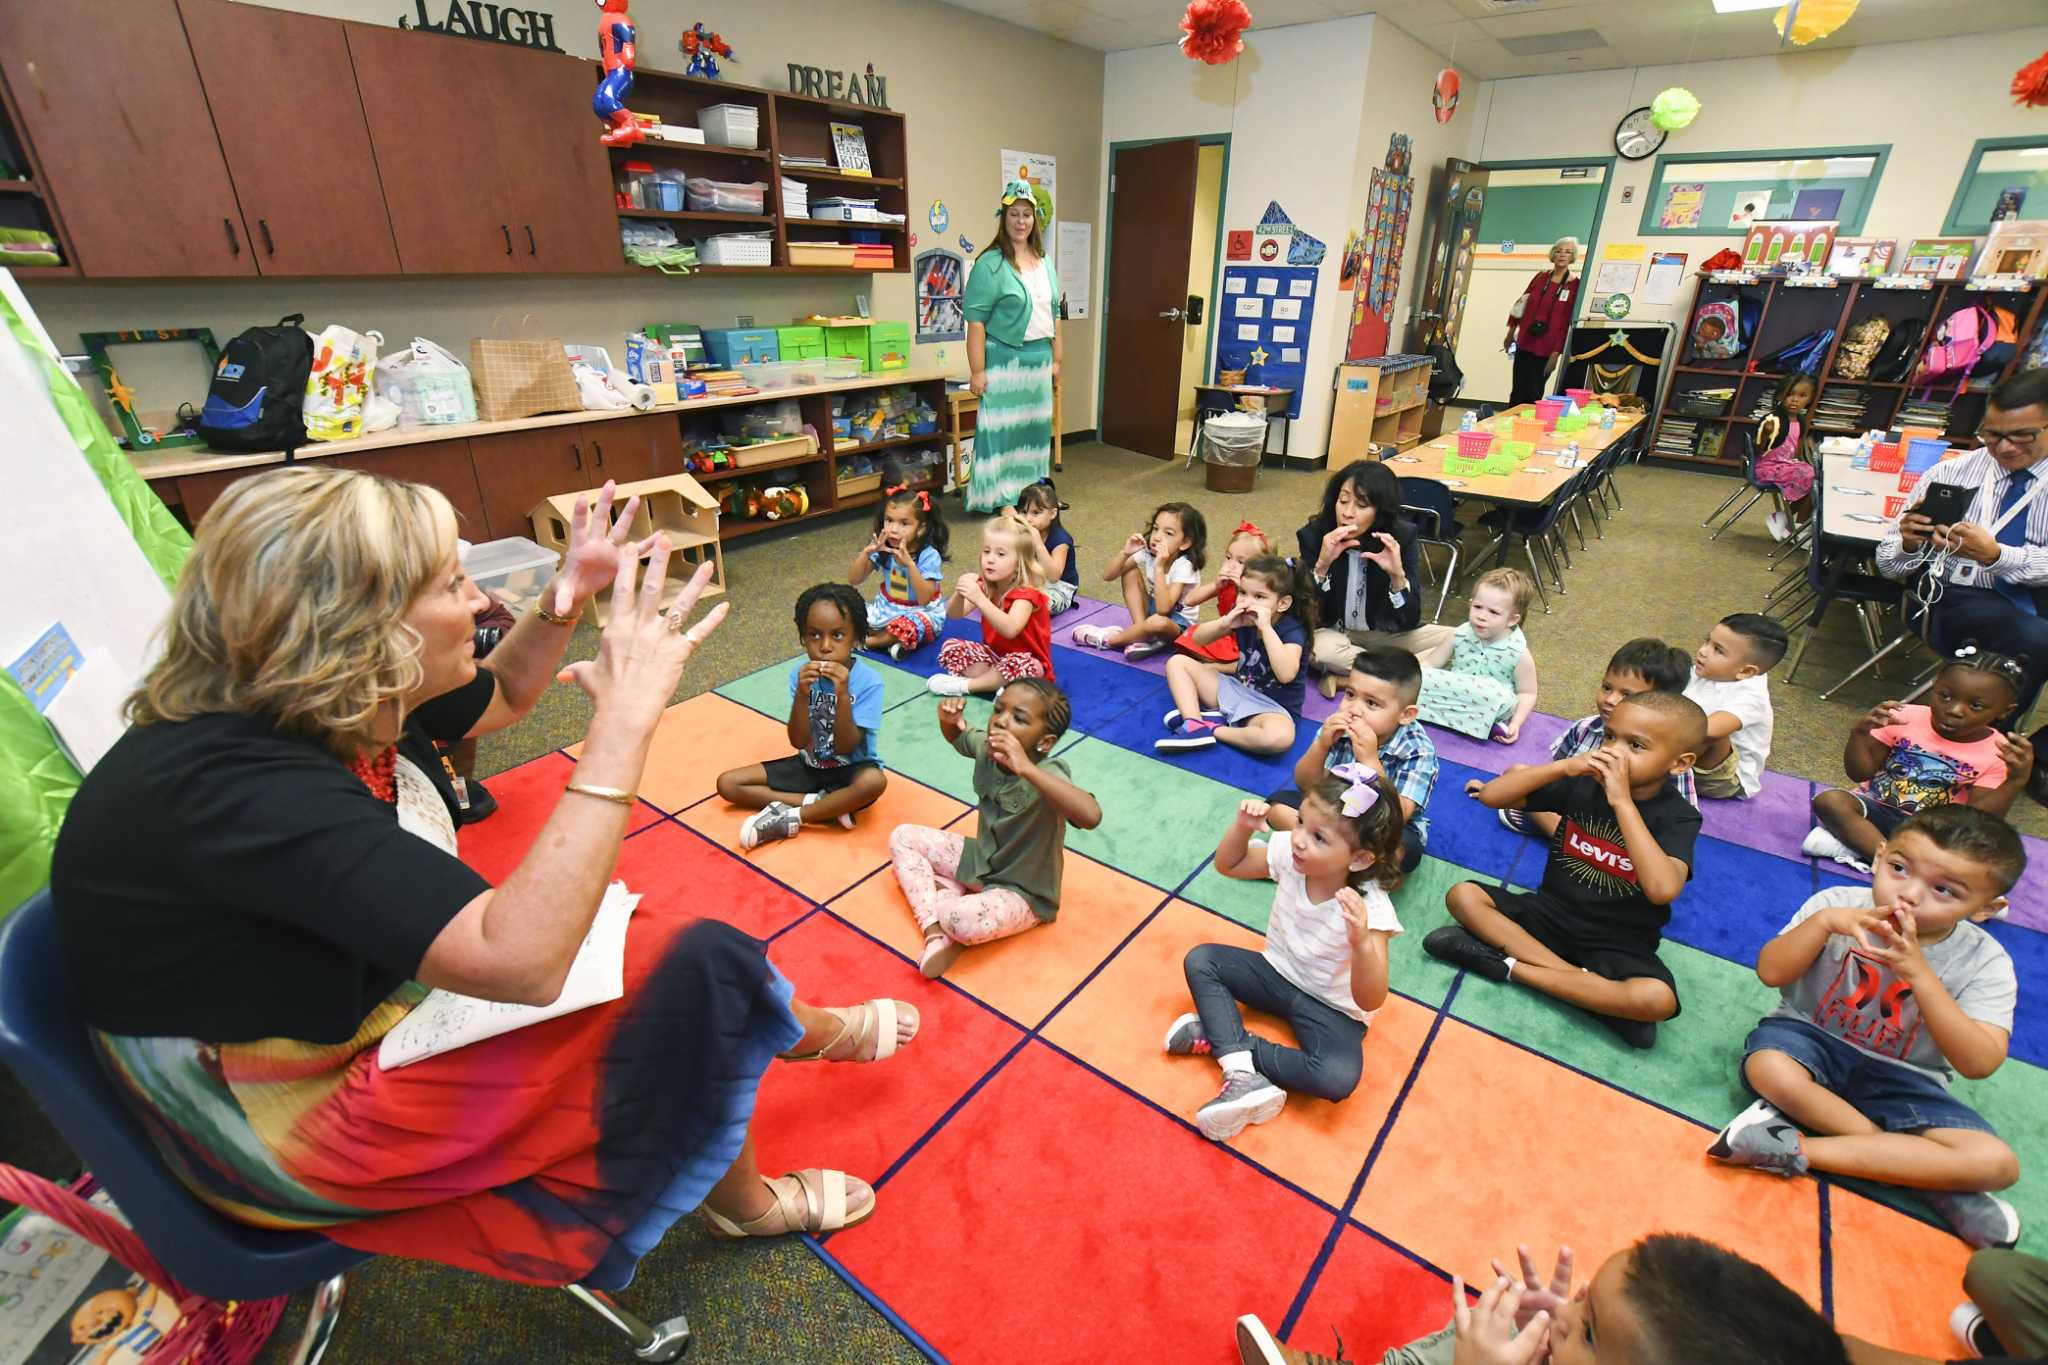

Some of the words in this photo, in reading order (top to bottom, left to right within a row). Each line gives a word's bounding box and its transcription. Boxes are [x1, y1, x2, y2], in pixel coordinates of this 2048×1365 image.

[413, 0, 566, 54] LAUGH
[787, 63, 892, 110] DREAM
[840, 155, 870, 172] KIDS
[1568, 832, 1635, 872] Levi's
